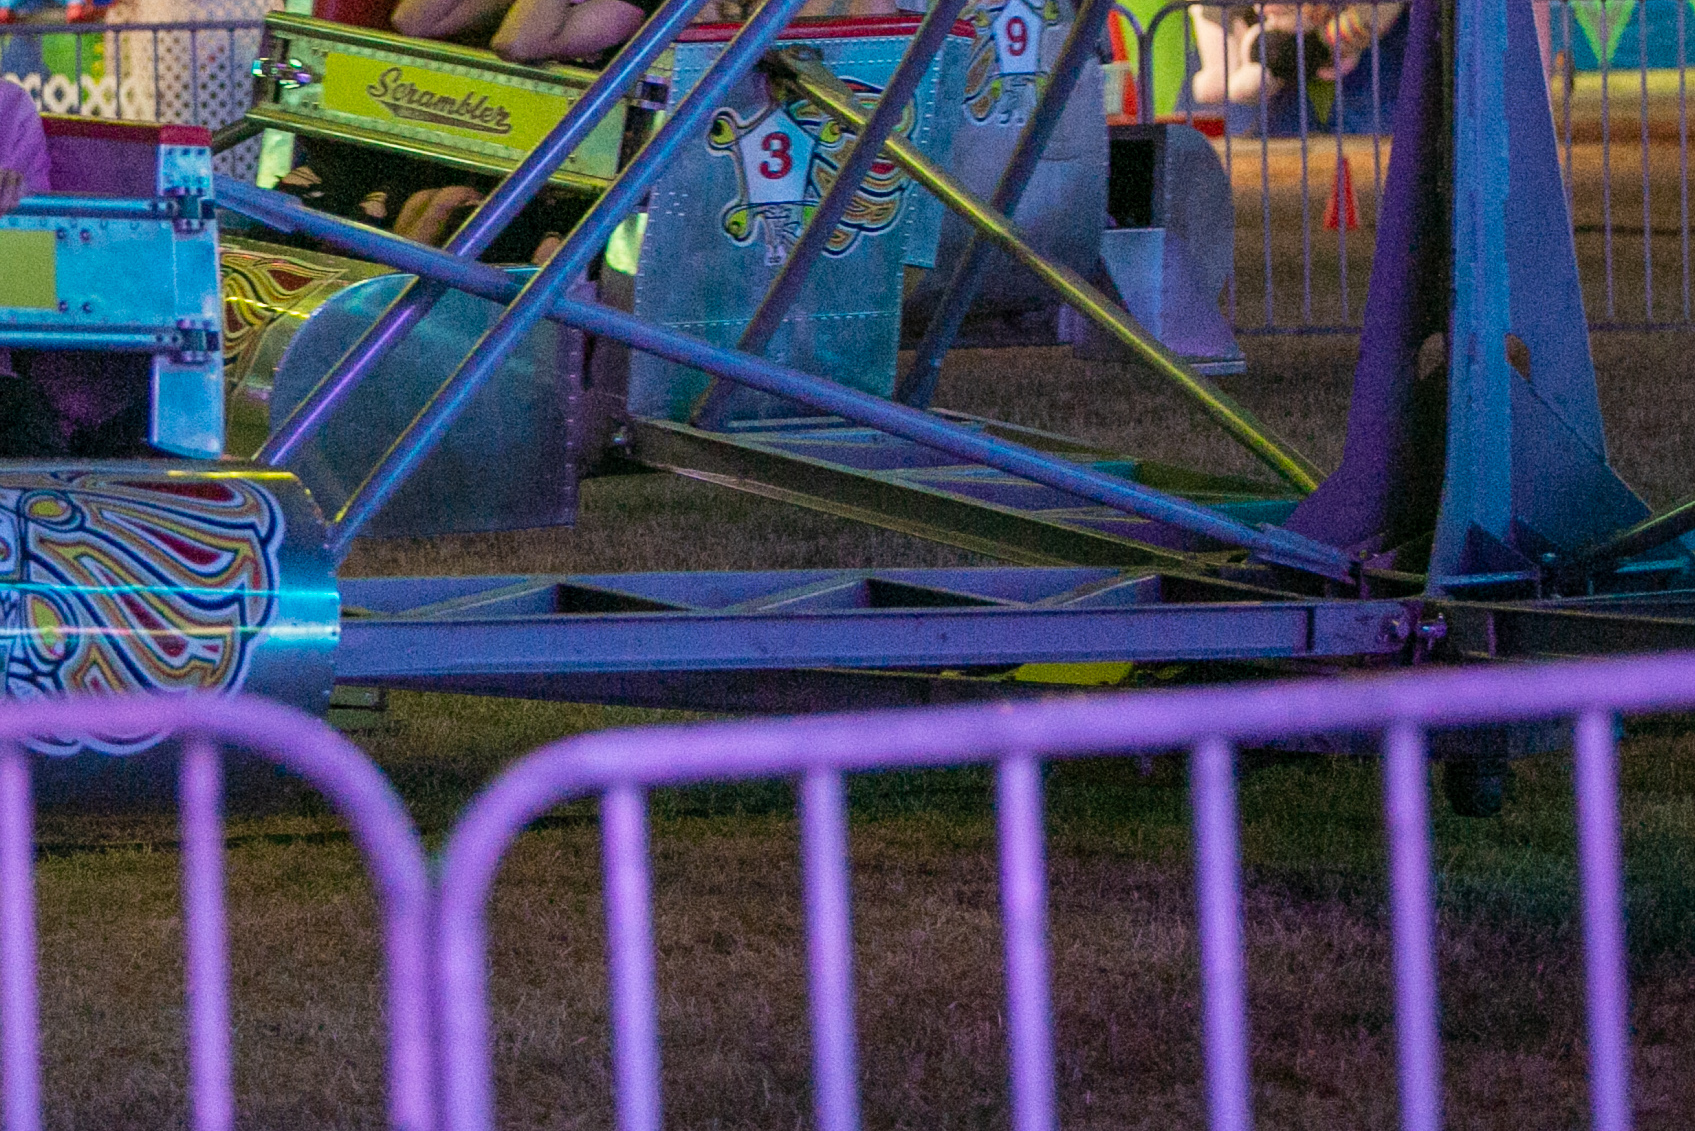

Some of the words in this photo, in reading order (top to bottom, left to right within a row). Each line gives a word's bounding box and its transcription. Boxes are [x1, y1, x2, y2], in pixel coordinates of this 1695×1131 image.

[1006, 16, 1029, 57] 9
[366, 66, 512, 128] Scrambler
[759, 132, 793, 180] 3
